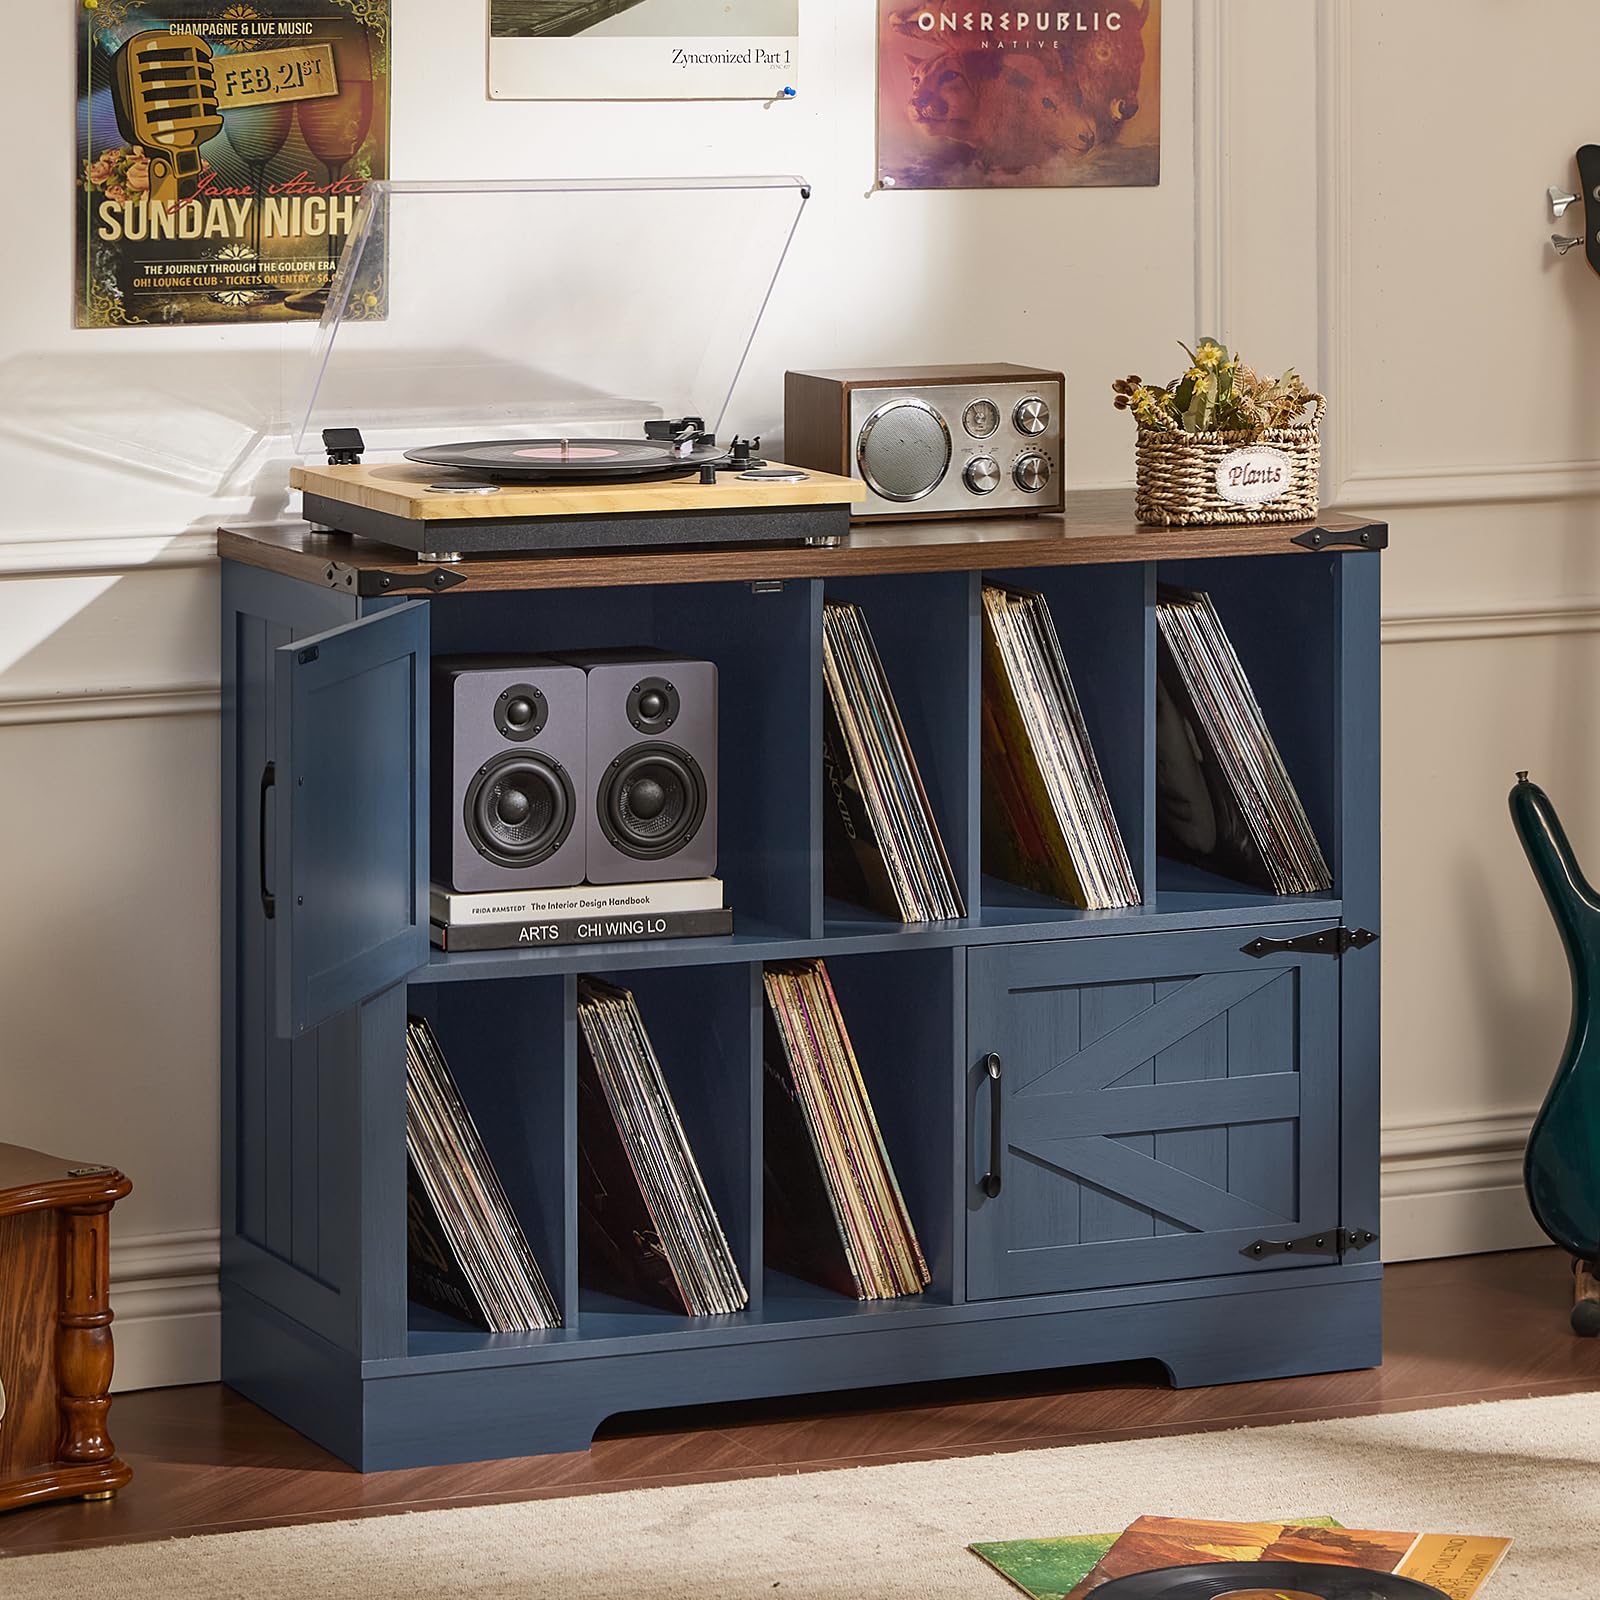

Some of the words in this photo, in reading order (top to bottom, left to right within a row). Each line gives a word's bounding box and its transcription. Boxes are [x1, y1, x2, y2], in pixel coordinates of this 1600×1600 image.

[169, 23, 238, 36] CHAMPAGNE
[241, 23, 249, 35] &
[251, 23, 275, 35] LIVE
[277, 22, 313, 35] MUSIC
[918, 12, 1121, 32] ONEREPUBLIC
[981, 40, 1059, 49] NATIVE
[672, 48, 751, 69] Zyncronized
[755, 48, 780, 64] Part
[784, 49, 791, 63] 1
[167, 172, 255, 215] Jane
[98, 197, 252, 241] SUNDAY
[264, 195, 361, 238] NIGH
[144, 265, 163, 275] THE
[164, 263, 209, 275] JOURNEY
[210, 263, 257, 273] THROUGH
[258, 262, 277, 272] THE
[277, 261, 316, 272] GOLDEN
[317, 261, 336, 271] ERA
[133, 277, 152, 287] OH!
[153, 277, 191, 287] LOUNGE
[193, 276, 218, 286] CLUB
[225, 275, 262, 285] TICKETS
[264, 274, 278, 284] ON
[279, 274, 311, 284] ENTRY
[1228, 462, 1282, 487] Plants
[472, 907, 491, 915] FRIDA
[492, 905, 526, 914] RAMSTEDT
[531, 902, 545, 911] The
[547, 901, 578, 911] Interior
[579, 898, 607, 909] Design
[608, 895, 651, 907] Handbook
[518, 925, 559, 942] ARTS
[577, 922, 602, 938] CHI
[605, 920, 644, 935] WING
[647, 918, 667, 933] LO
